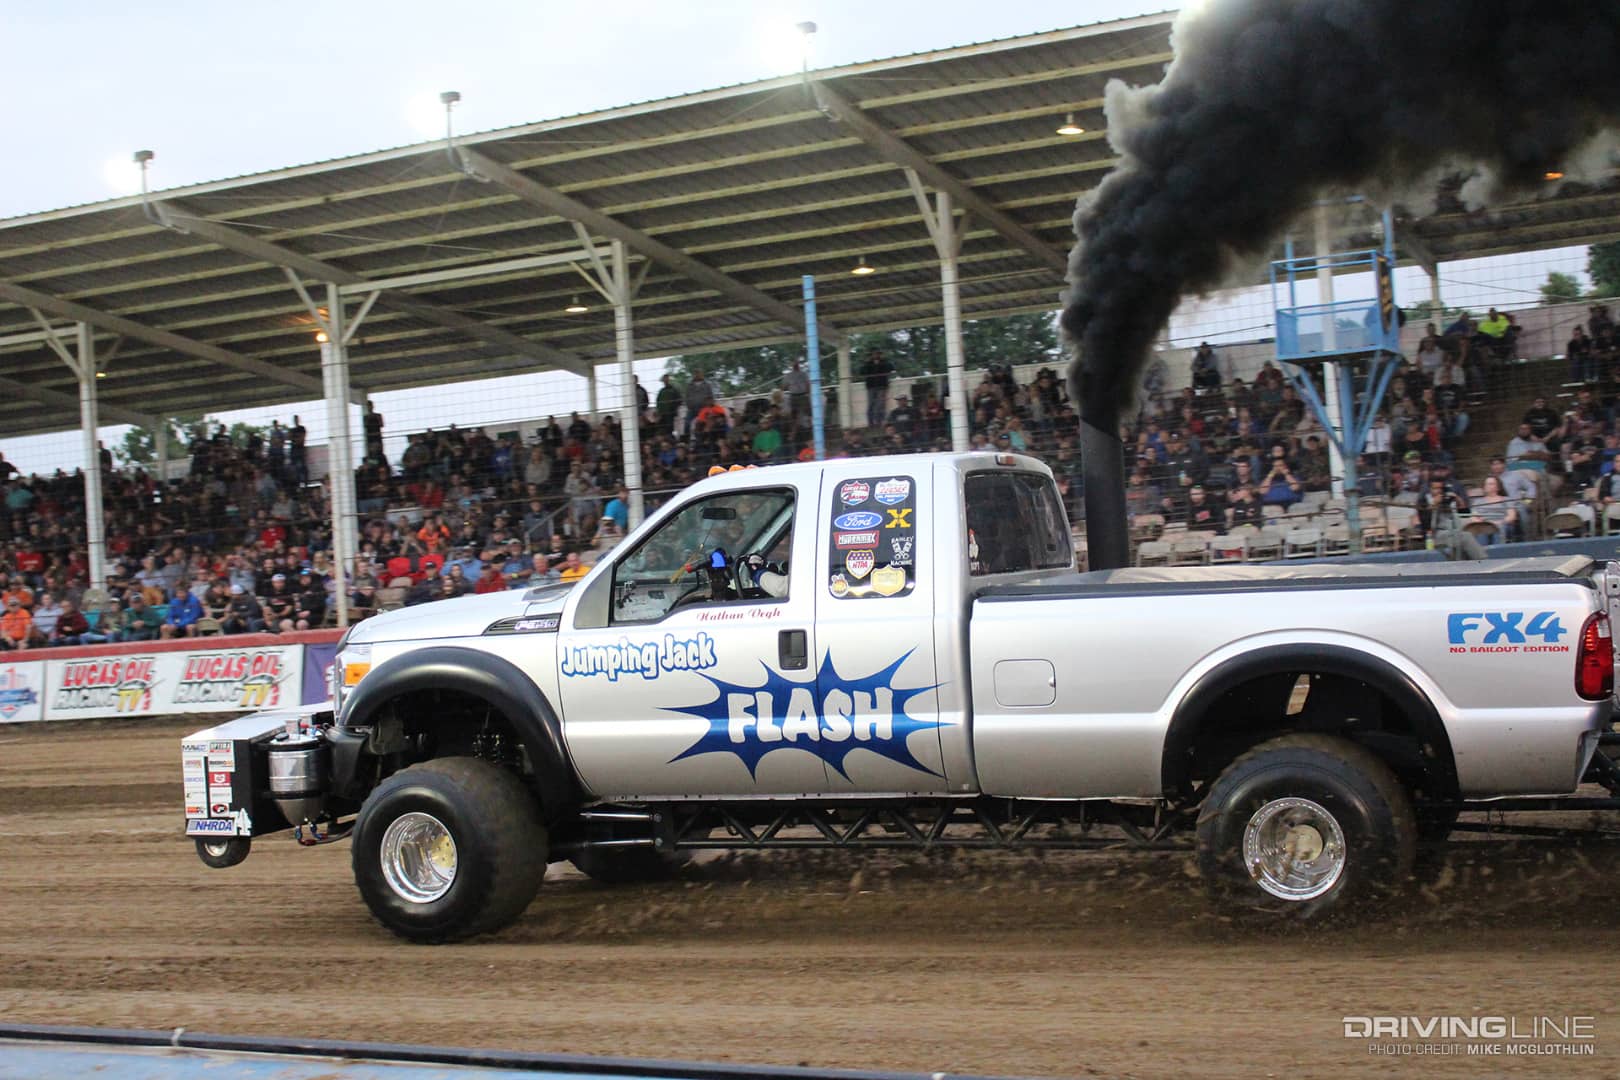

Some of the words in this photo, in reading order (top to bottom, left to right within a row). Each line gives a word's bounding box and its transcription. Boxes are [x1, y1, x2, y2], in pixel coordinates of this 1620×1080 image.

[843, 513, 873, 527] Ford
[696, 611, 744, 621] Nathan
[1447, 611, 1568, 644] FX4
[184, 655, 249, 681] LUCAS
[250, 653, 281, 676] OIL
[561, 637, 660, 681] Jumping
[660, 632, 718, 671] Jack
[62, 662, 122, 687] LUCAS
[124, 660, 154, 681] OIL
[54, 687, 116, 709] RACING
[117, 688, 145, 712] TV
[174, 682, 242, 704] RACING
[240, 684, 272, 707] TV
[726, 686, 894, 743] FLASH
[195, 820, 232, 831] NHRDA
